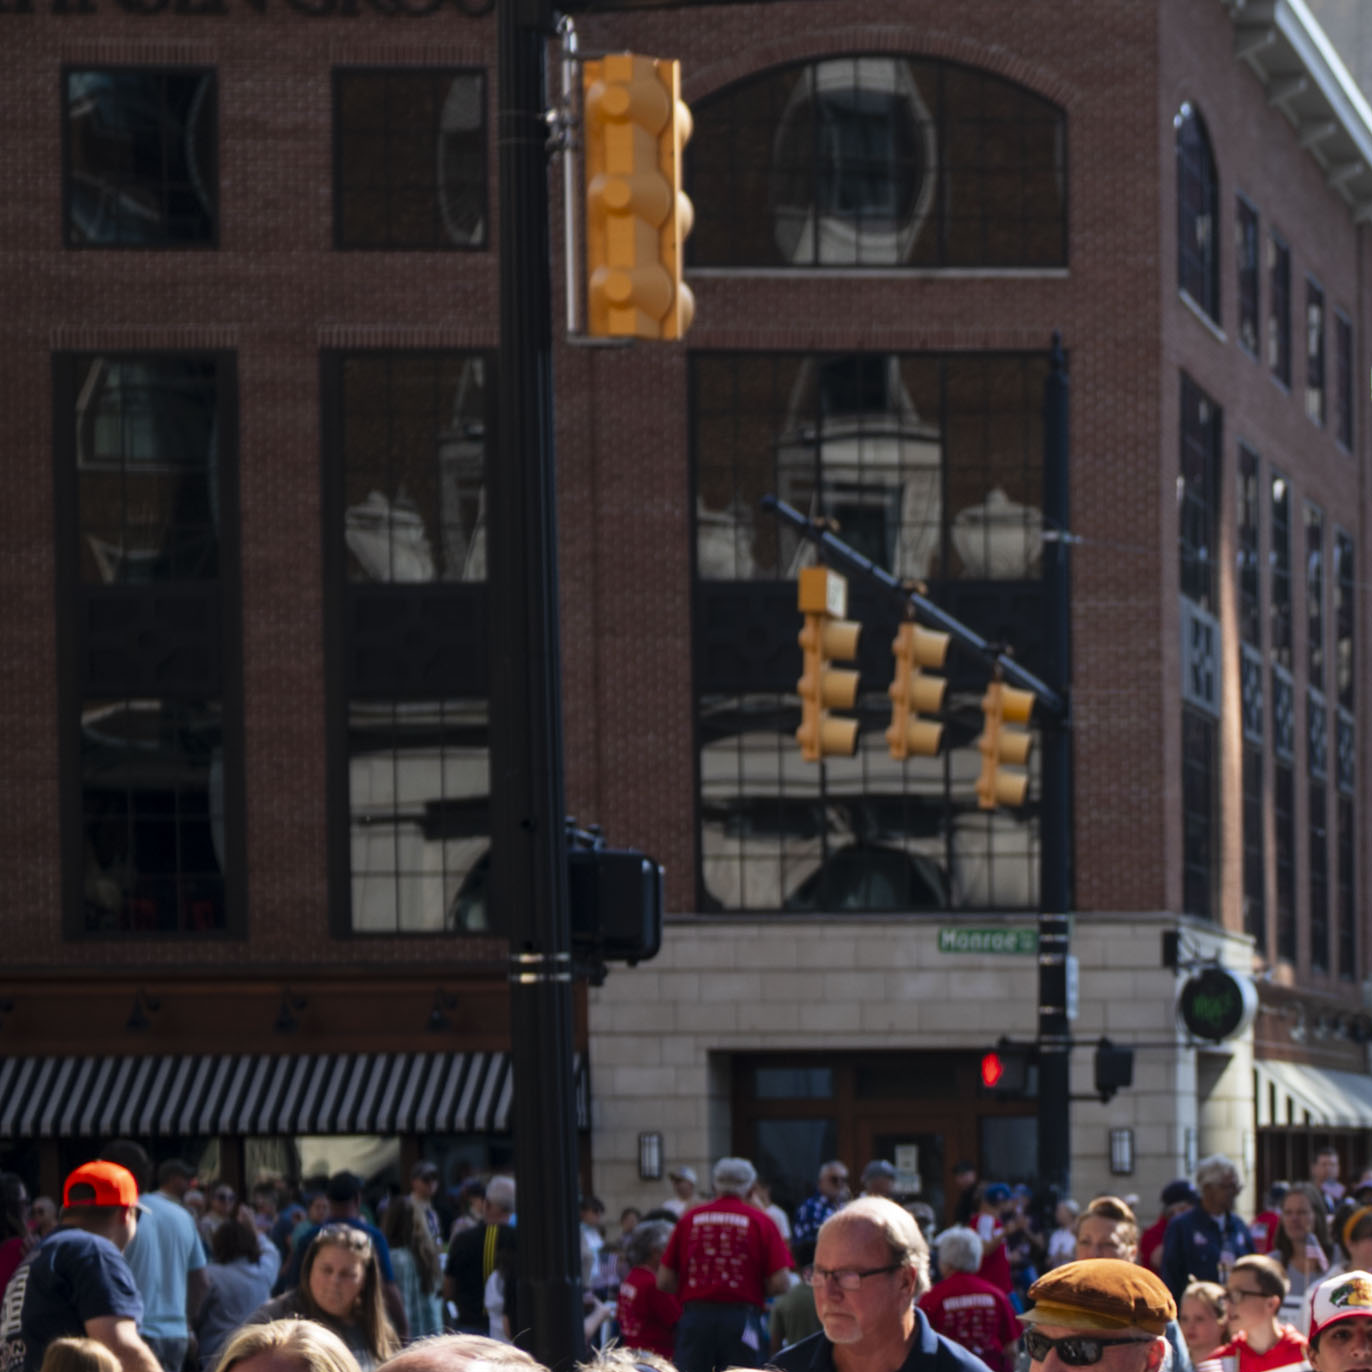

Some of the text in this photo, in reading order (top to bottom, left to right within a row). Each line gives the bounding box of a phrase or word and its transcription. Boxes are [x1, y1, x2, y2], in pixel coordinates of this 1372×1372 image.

[941, 929, 1018, 952] Monroe
[693, 1212, 749, 1227] VOLUNTEER
[942, 1296, 996, 1311] VOLUNTEER
